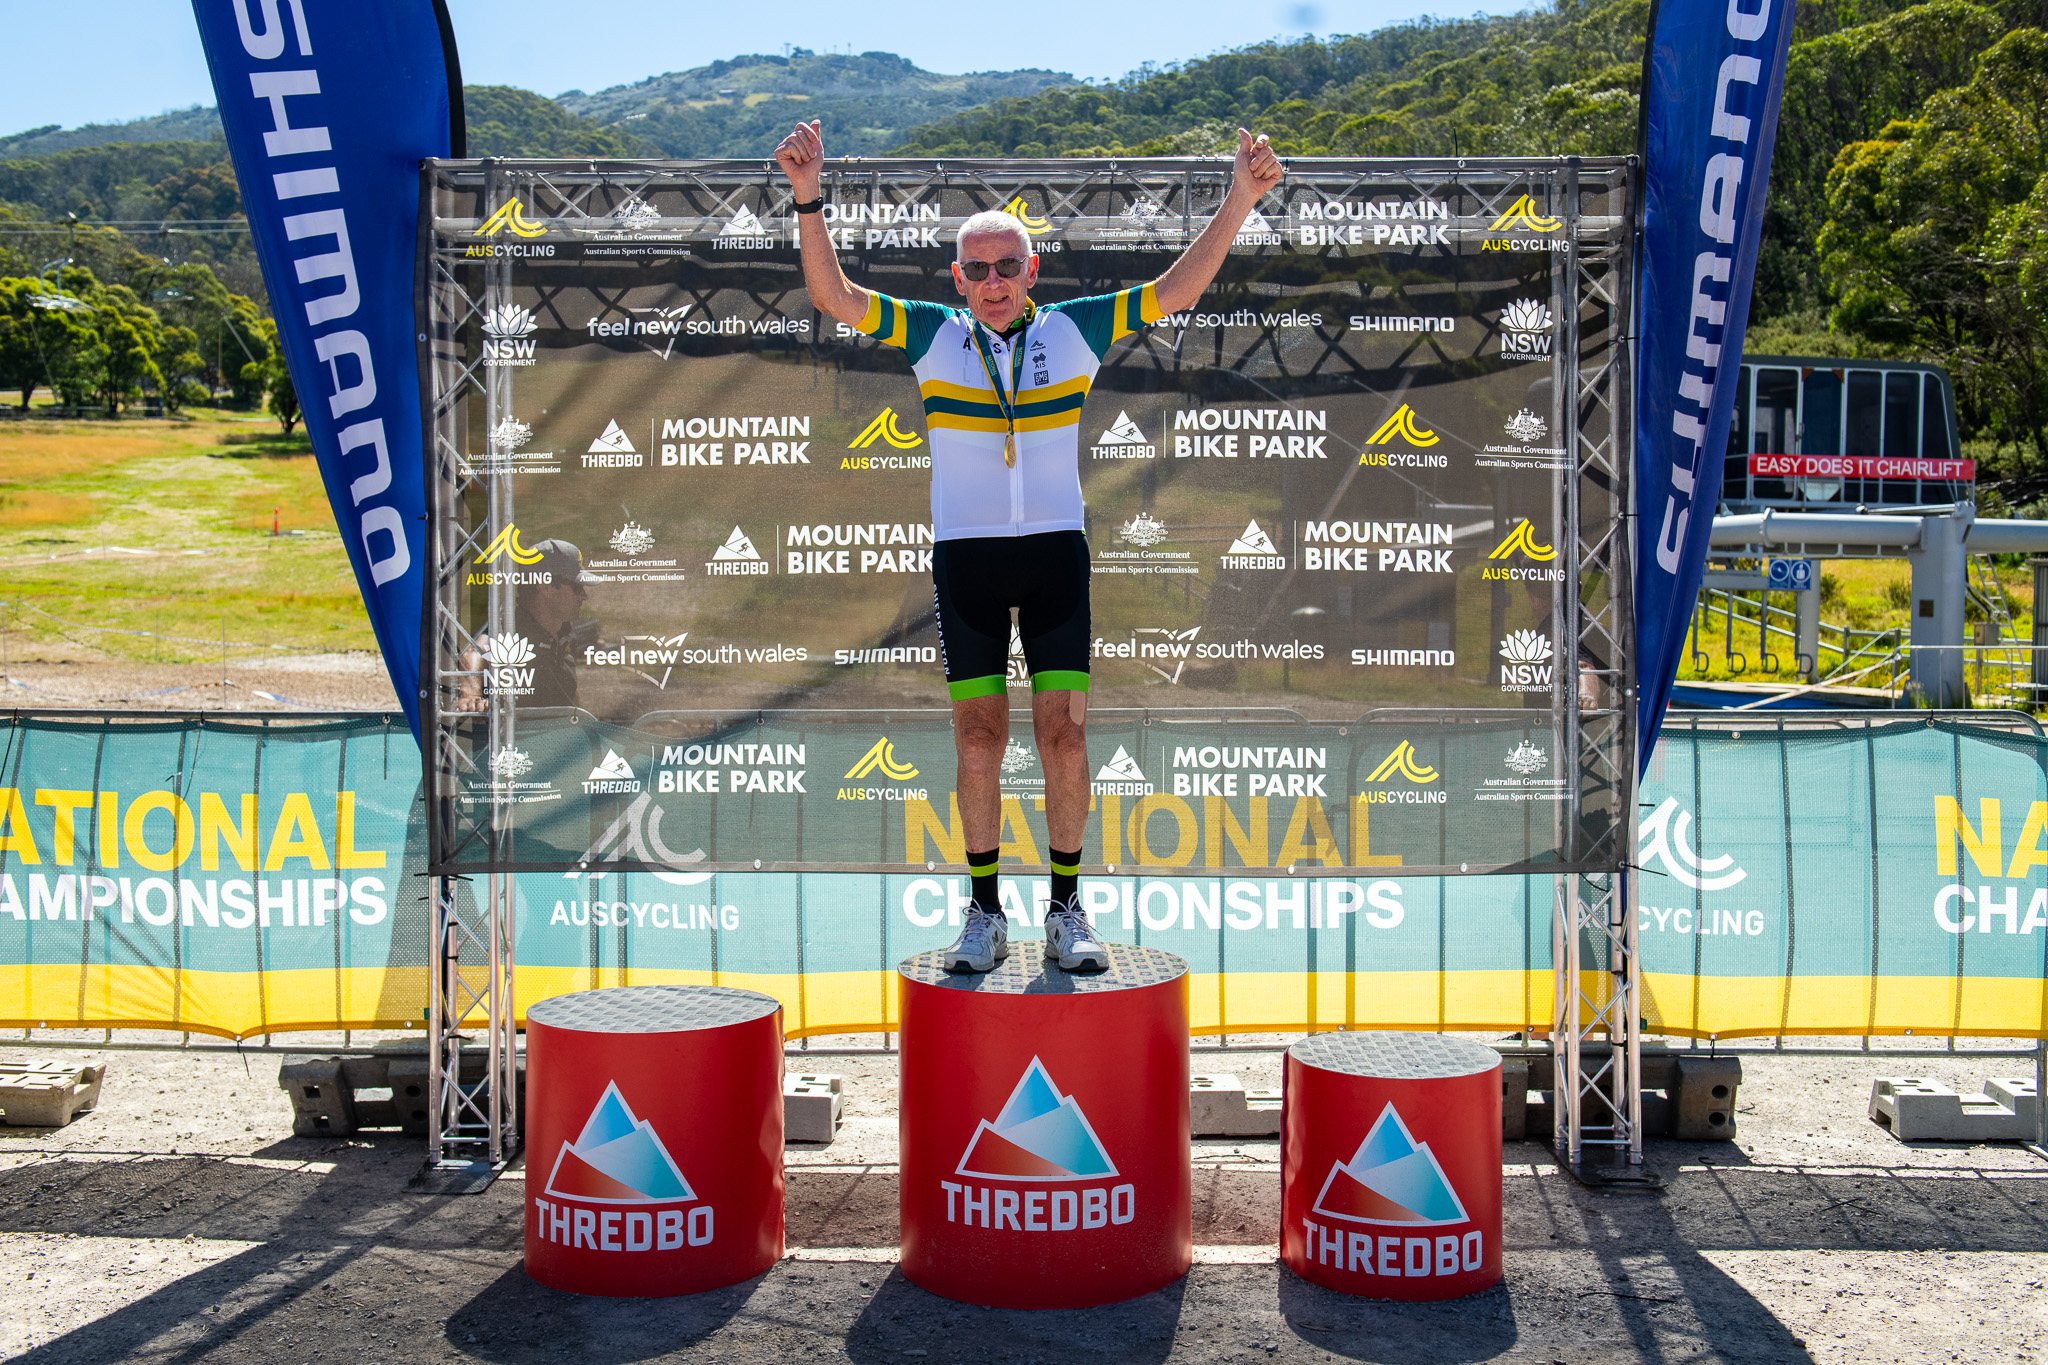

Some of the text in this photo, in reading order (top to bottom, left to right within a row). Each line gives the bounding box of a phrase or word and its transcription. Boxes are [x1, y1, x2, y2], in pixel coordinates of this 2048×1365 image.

[793, 203, 941, 223] OUNTAIN
[1299, 201, 1448, 220] MOUNTAIN
[593, 233, 682, 241] Australian Government
[866, 227, 941, 249] PARK
[1099, 230, 1188, 238] Australian Government
[1232, 233, 1282, 246] REDBO
[1300, 224, 1451, 246] BIKE PARK
[711, 237, 774, 249] THREDBO
[1128, 243, 1152, 251] Sports
[1482, 239, 1570, 252] AUSCYCLING
[465, 245, 555, 257] AUSCYCLING
[583, 247, 691, 257] Australian Sports Commission
[587, 315, 810, 336] feel new south wales
[1150, 309, 1322, 328] ew south wales
[1350, 316, 1455, 333] SHIMANO
[482, 340, 537, 359] NSW
[1501, 333, 1551, 354] NSW
[1501, 352, 1551, 362] GOVERNMENT
[661, 416, 810, 439] MOUNTAIN
[1174, 409, 1327, 431] MOUNTAIN
[661, 442, 811, 466] BIKE PARK
[1090, 445, 1155, 459] THREDBO
[1174, 435, 1328, 459] BIKE PARK
[1483, 444, 1567, 455] Australian Government
[467, 451, 553, 461] Australian Government
[581, 454, 643, 468] THREDBO
[840, 456, 932, 470] AUSCYCLING
[1359, 453, 1448, 468] AUSCYCLING
[459, 465, 561, 476] Australian Sports Commission
[1475, 458, 1574, 470] Australian Sports Commission
[1757, 457, 1963, 477] EASY DOES IT CHAIRLIFT
[787, 523, 936, 547] MOUNTAIN
[1304, 521, 1453, 545] MOUNTAIN
[787, 550, 933, 575] BIKE PARK
[1098, 550, 1190, 560] Australian Government
[1305, 547, 1454, 573] BIKE PARK
[588, 559, 677, 567] Australian Government
[705, 561, 769, 576] THREDBO
[1128, 565, 1153, 575] Sports
[1154, 565, 1199, 574] Commission
[1220, 556, 1285, 570] THREDBO
[466, 571, 552, 586] AUSCYCLING
[580, 573, 685, 583] Australian Sports Commission
[1482, 567, 1565, 582] AUSCYCLING
[584, 643, 808, 665] feel new south wales
[834, 646, 937, 665] SHIMANO
[1092, 638, 1325, 659] feel new south wales
[1351, 649, 1455, 666] SHIMANO
[483, 668, 535, 687] NSW
[1501, 665, 1552, 684] NSW
[483, 687, 535, 695] GOVERNMENT
[661, 744, 806, 766] MOUNTAIN
[1173, 746, 1327, 769] MOUNTAIN
[468, 781, 551, 789] Australian Government
[581, 780, 641, 794] THREDBO
[658, 770, 807, 793] BIKE PARK
[1009, 777, 1045, 785] Governm
[1174, 773, 1327, 797] BIKE PARK
[1483, 777, 1567, 786] Australian Government
[837, 788, 928, 801] AUSCYCLING
[1091, 782, 1154, 796] THREDBO
[1474, 791, 1574, 802] Australian Sports Commission
[460, 793, 562, 805] Australian Sports Commission
[1001, 792, 1020, 802] ports
[1358, 791, 1447, 804] AUSCYCLING
[550, 900, 739, 931] AUSCYCLING
[940, 1180, 1135, 1232] THREDBO
[535, 1197, 714, 1253] THREDBO
[1302, 1218, 1483, 1278] THREDBO
